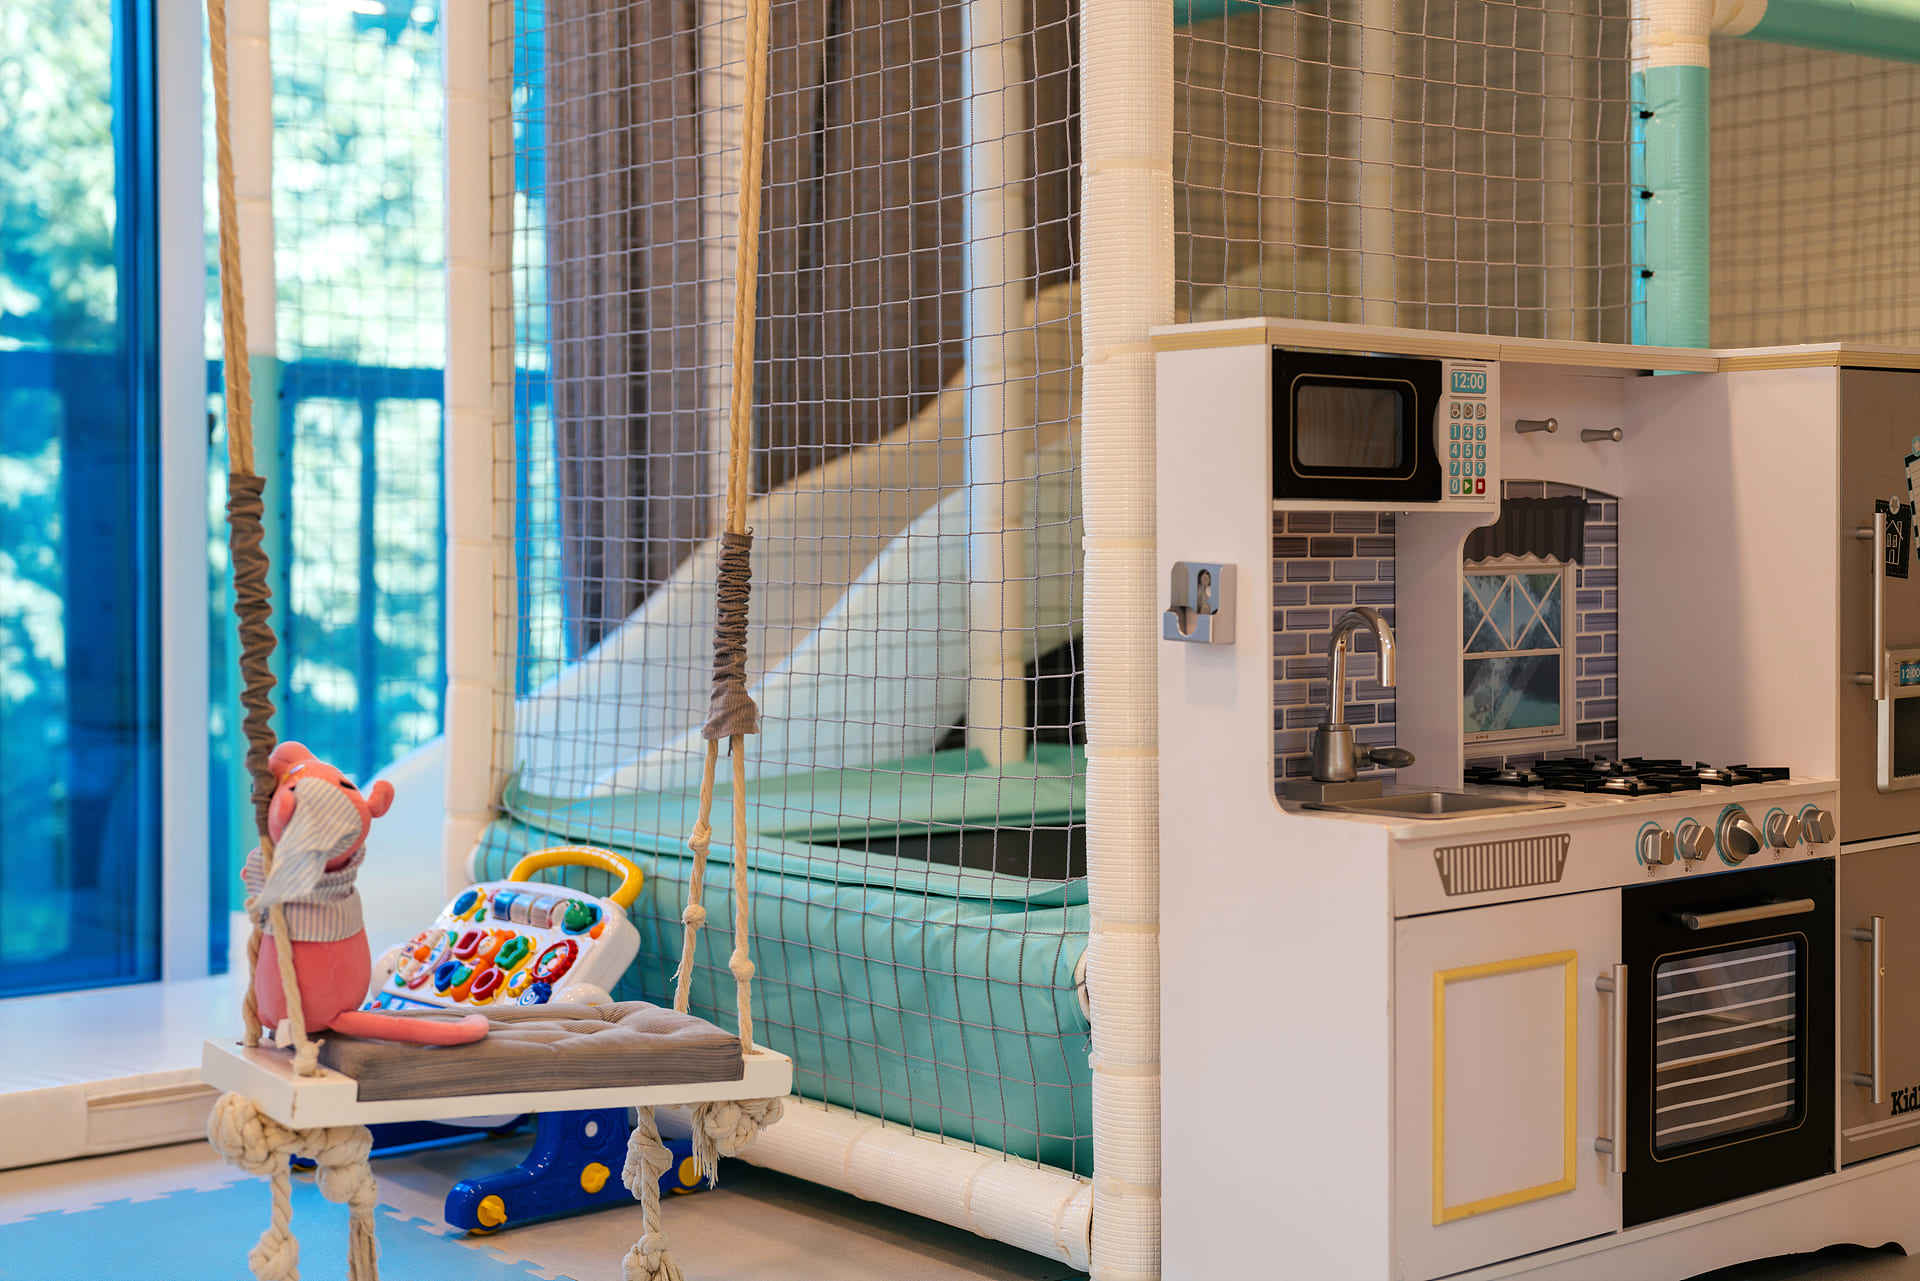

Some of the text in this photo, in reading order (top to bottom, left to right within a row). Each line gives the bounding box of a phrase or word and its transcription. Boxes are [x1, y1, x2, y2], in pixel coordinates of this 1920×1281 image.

[1453, 373, 1484, 389] 12:00
[1465, 426, 1471, 438] 2
[1478, 427, 1484, 439] 3
[1452, 444, 1483, 457] 4 5 6
[1452, 462, 1483, 474] 7 8 9
[1452, 479, 1458, 492] 0
[1890, 1085, 1920, 1116] Kid
